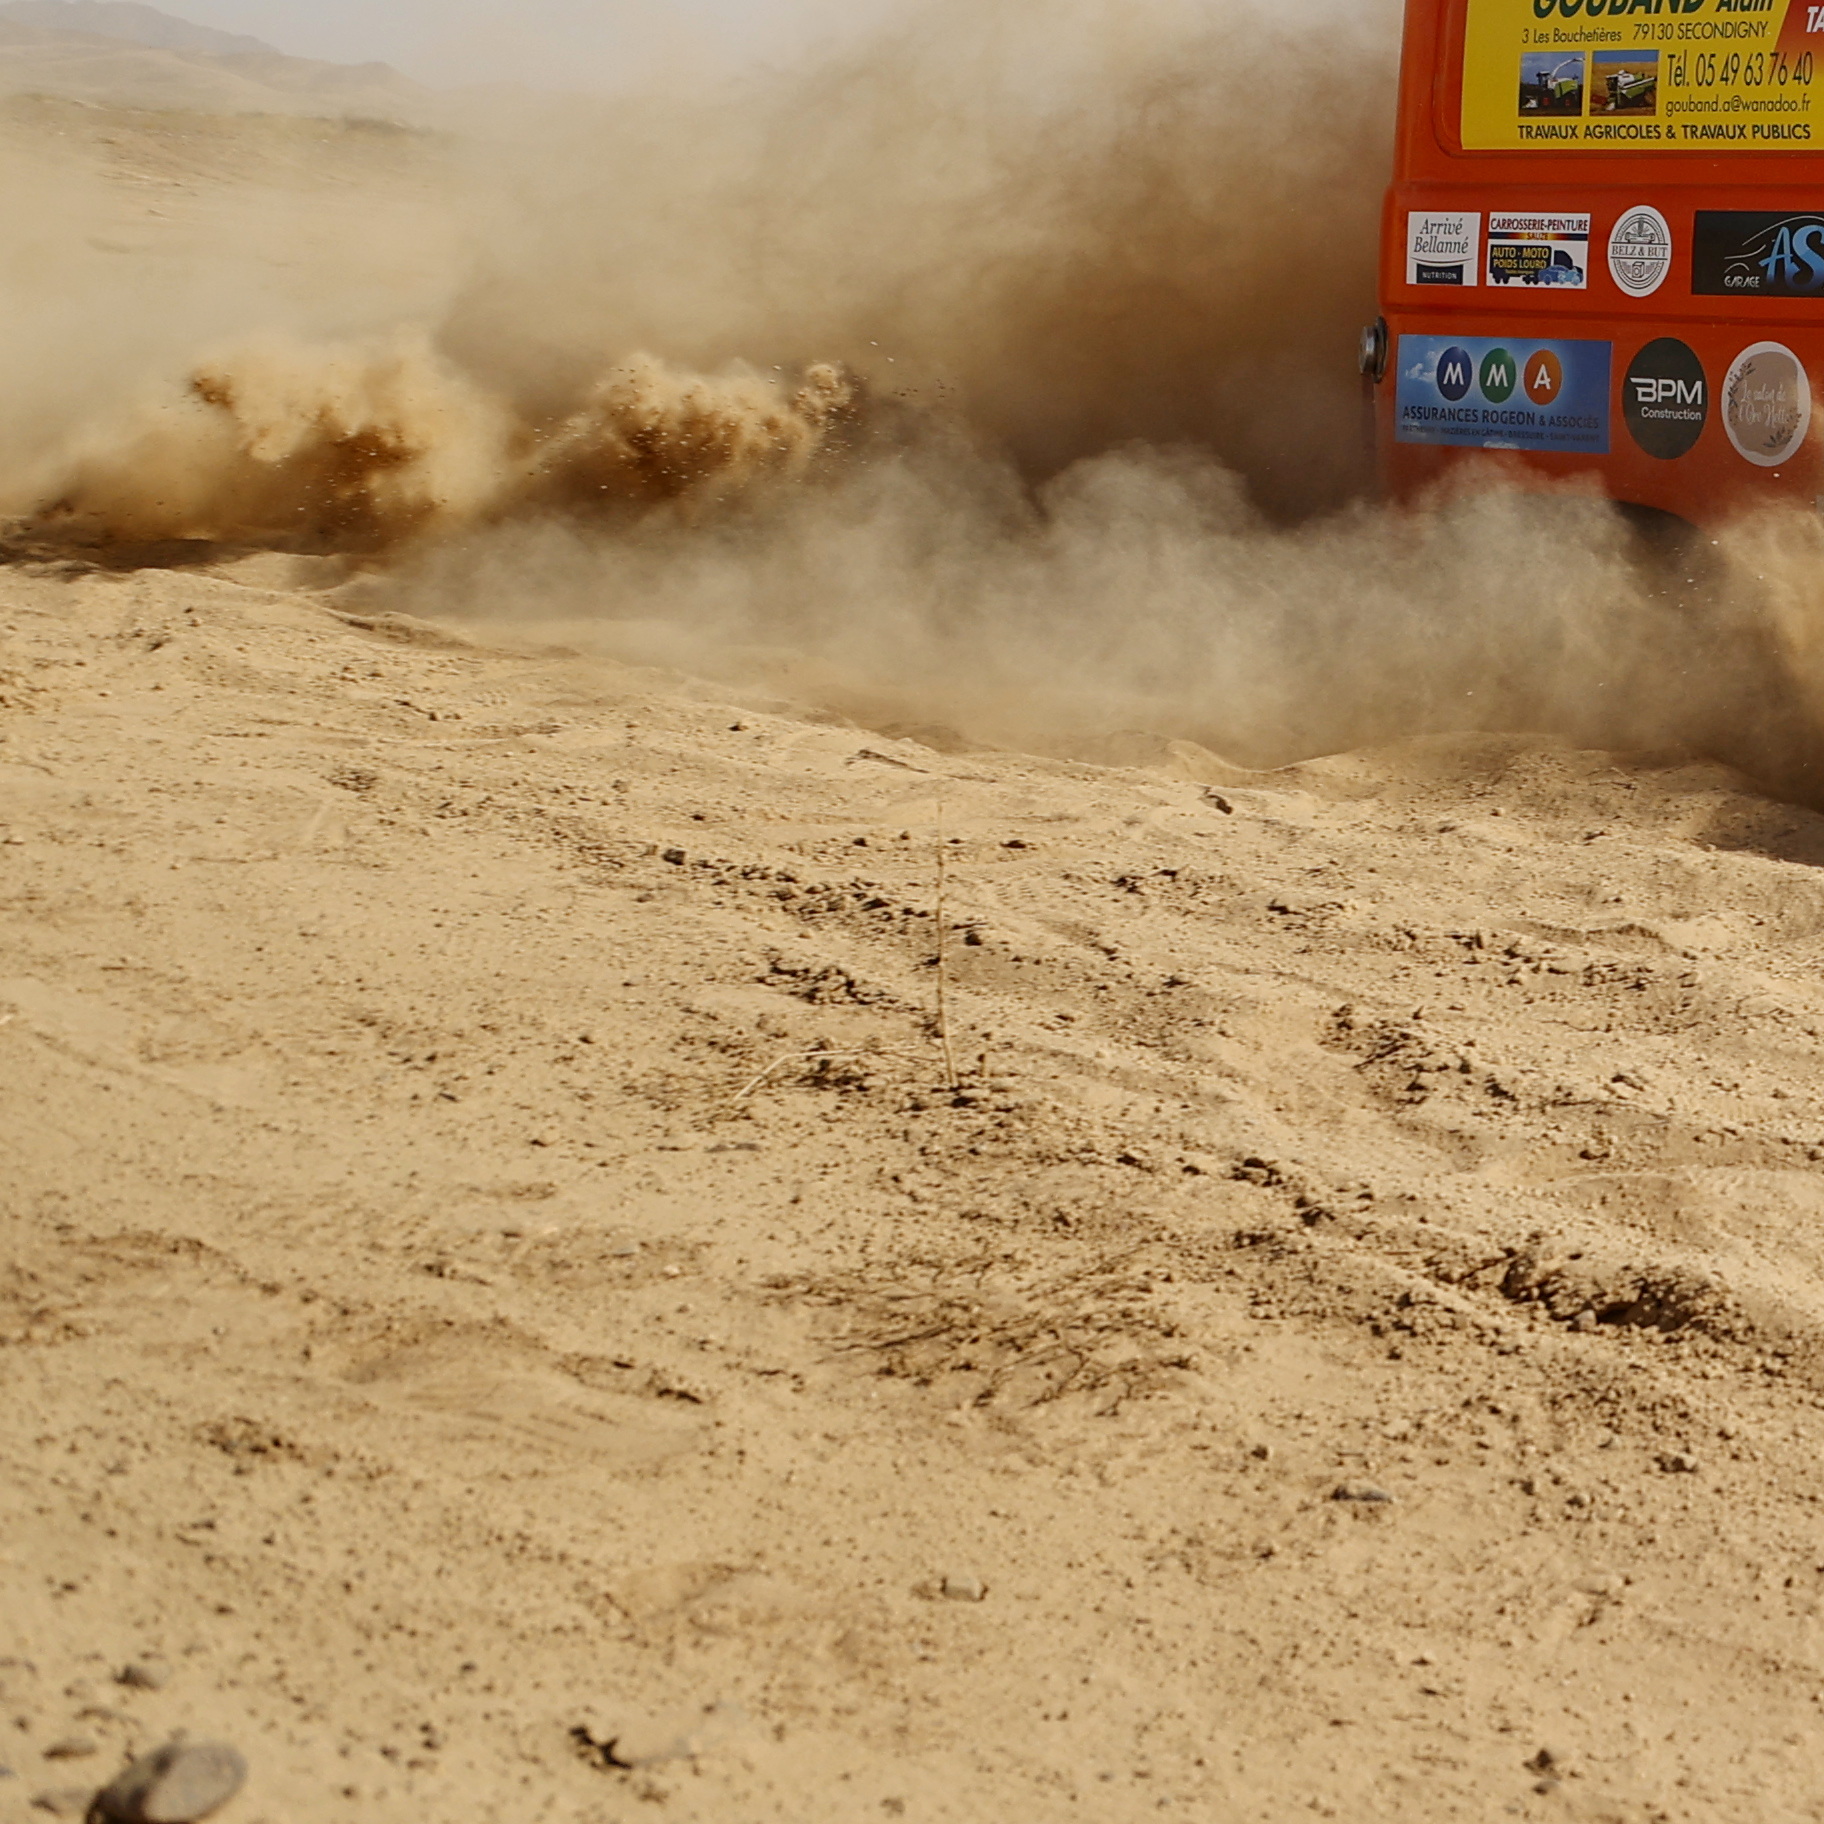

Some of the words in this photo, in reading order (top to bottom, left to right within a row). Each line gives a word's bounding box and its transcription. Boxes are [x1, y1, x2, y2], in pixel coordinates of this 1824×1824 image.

[1522, 28, 1529, 44] 3
[1533, 28, 1550, 43] Les
[1553, 26, 1622, 43] Bouchetières
[1633, 23, 1673, 41] 79130
[1677, 21, 1768, 40] SECONDIGNY
[1667, 53, 1690, 87] Tél.
[1696, 53, 1715, 87] 05
[1720, 53, 1742, 87] 49
[1744, 52, 1765, 86] 63
[1767, 51, 1788, 86] 76
[1792, 50, 1813, 86] 40
[1666, 94, 1811, 118] gouband.a@wanadoo.fr
[1517, 125, 1578, 140] TRAVAUX
[1584, 125, 1661, 140] AGRICOLES
[1666, 125, 1676, 140] &
[1681, 125, 1746, 140] TRAVAUX
[1752, 124, 1811, 140] PUBLICS
[1420, 217, 1463, 235] Arrivé
[1414, 236, 1470, 255] Bellanné
[1492, 247, 1516, 258] AUTO
[1522, 247, 1549, 259] MOTO
[1638, 246, 1645, 257] &
[1493, 258, 1518, 269] POIDS
[1724, 276, 1760, 289] GARAGE
[1630, 377, 1702, 405] BPM
[1402, 406, 1478, 424] ASSURANCES
[1482, 410, 1535, 426] ROGEON
[1539, 415, 1546, 426] &
[1641, 407, 1702, 421] Construction
